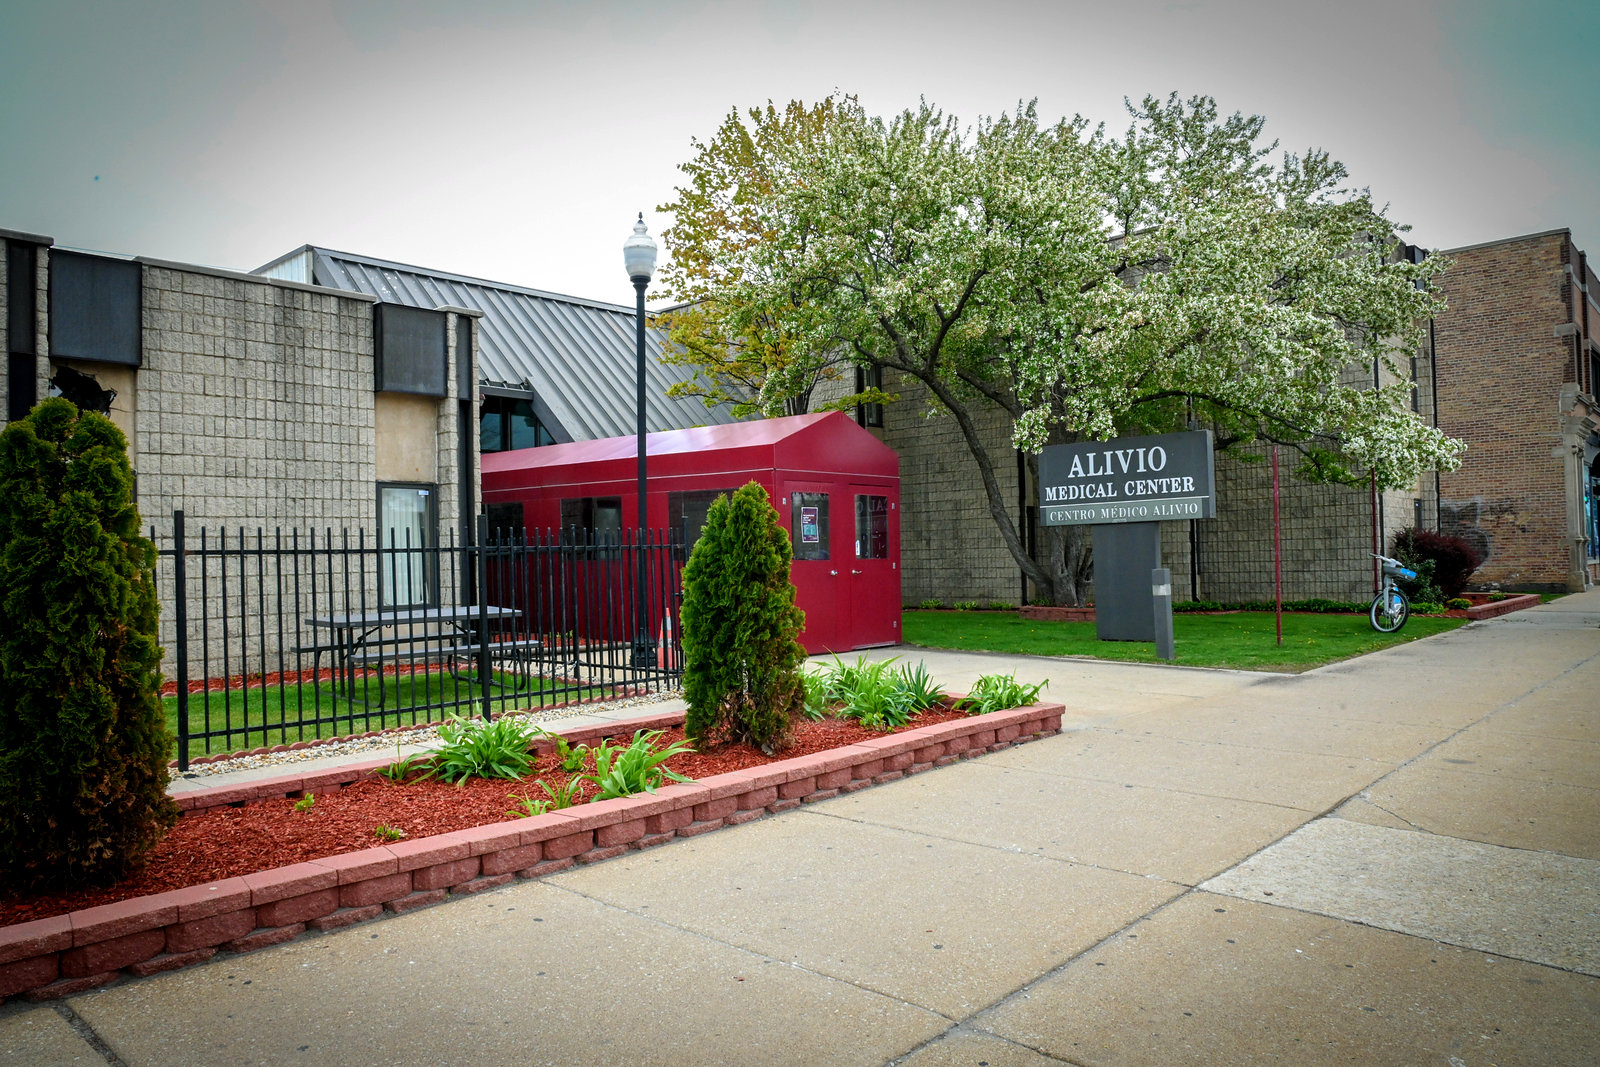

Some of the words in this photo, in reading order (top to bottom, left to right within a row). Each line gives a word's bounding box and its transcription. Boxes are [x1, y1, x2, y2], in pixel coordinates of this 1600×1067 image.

[1067, 446, 1167, 478] ALIVIO
[1045, 482, 1118, 501] MEDICAL
[1124, 476, 1196, 496] CENTER
[1050, 508, 1096, 522] CENTRO
[1101, 505, 1148, 519] MÉDICO
[1152, 502, 1199, 516] ALIVIO
